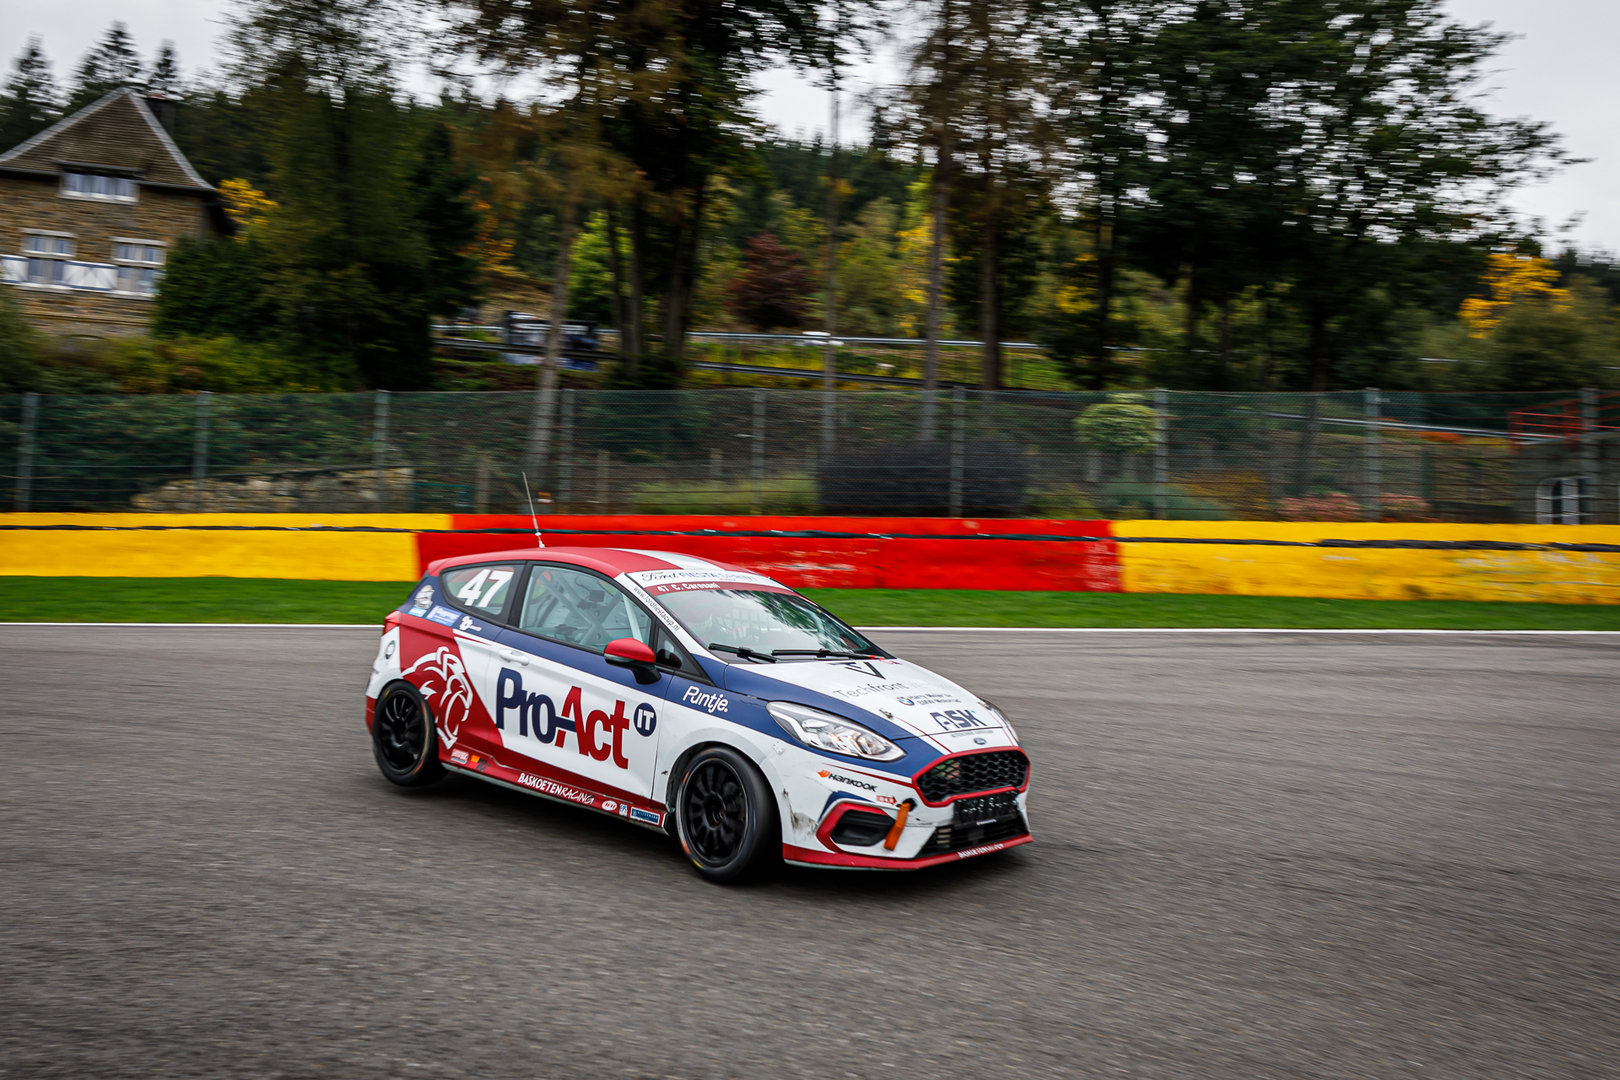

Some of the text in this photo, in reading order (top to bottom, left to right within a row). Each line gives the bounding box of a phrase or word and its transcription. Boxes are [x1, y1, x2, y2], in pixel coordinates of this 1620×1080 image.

[641, 571, 680, 582] Ford
[456, 568, 514, 608] 47
[657, 585, 670, 593] 47
[633, 586, 681, 632] www.fordfiestacup.nl
[833, 682, 909, 699] Techfront
[637, 708, 655, 732] IT
[929, 709, 988, 731] ASK
